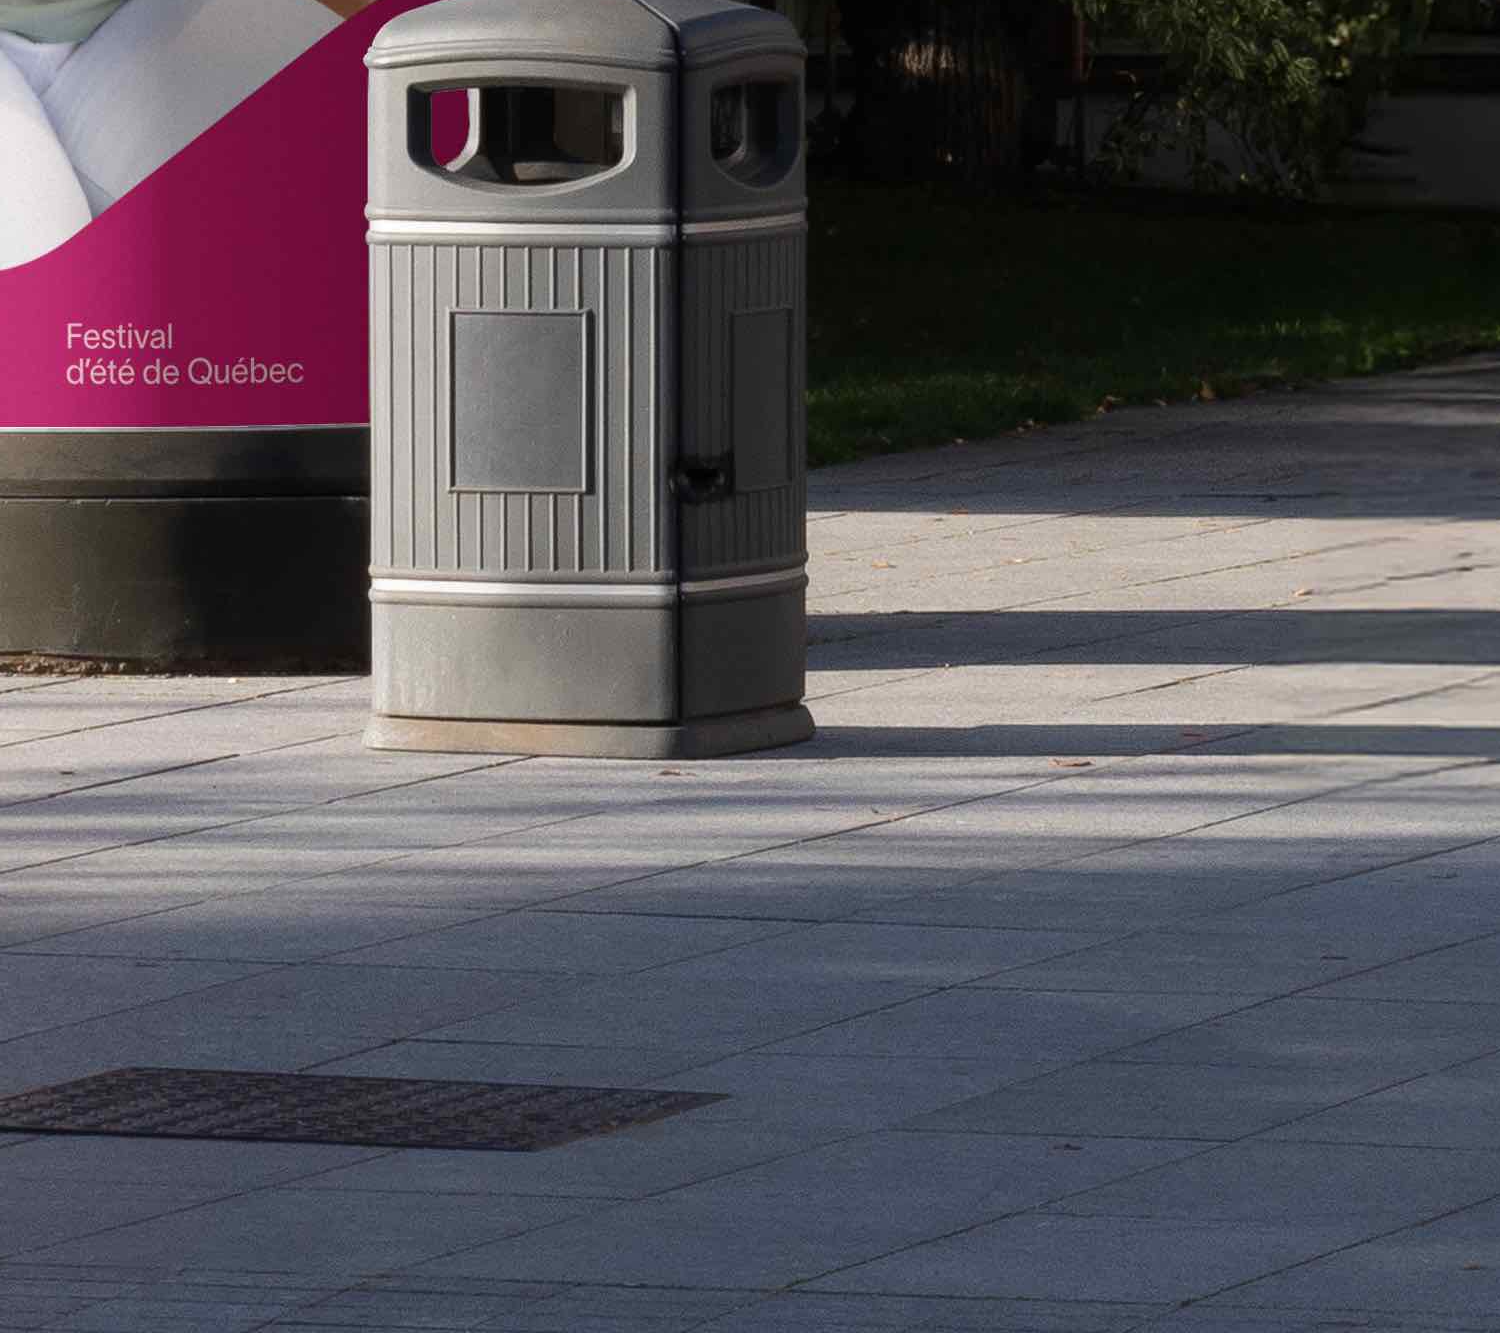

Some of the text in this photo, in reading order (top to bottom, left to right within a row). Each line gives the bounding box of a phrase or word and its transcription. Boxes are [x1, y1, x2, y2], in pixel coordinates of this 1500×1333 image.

[66, 323, 173, 351] Festival
[143, 358, 180, 385] de
[187, 356, 305, 385] Québec
